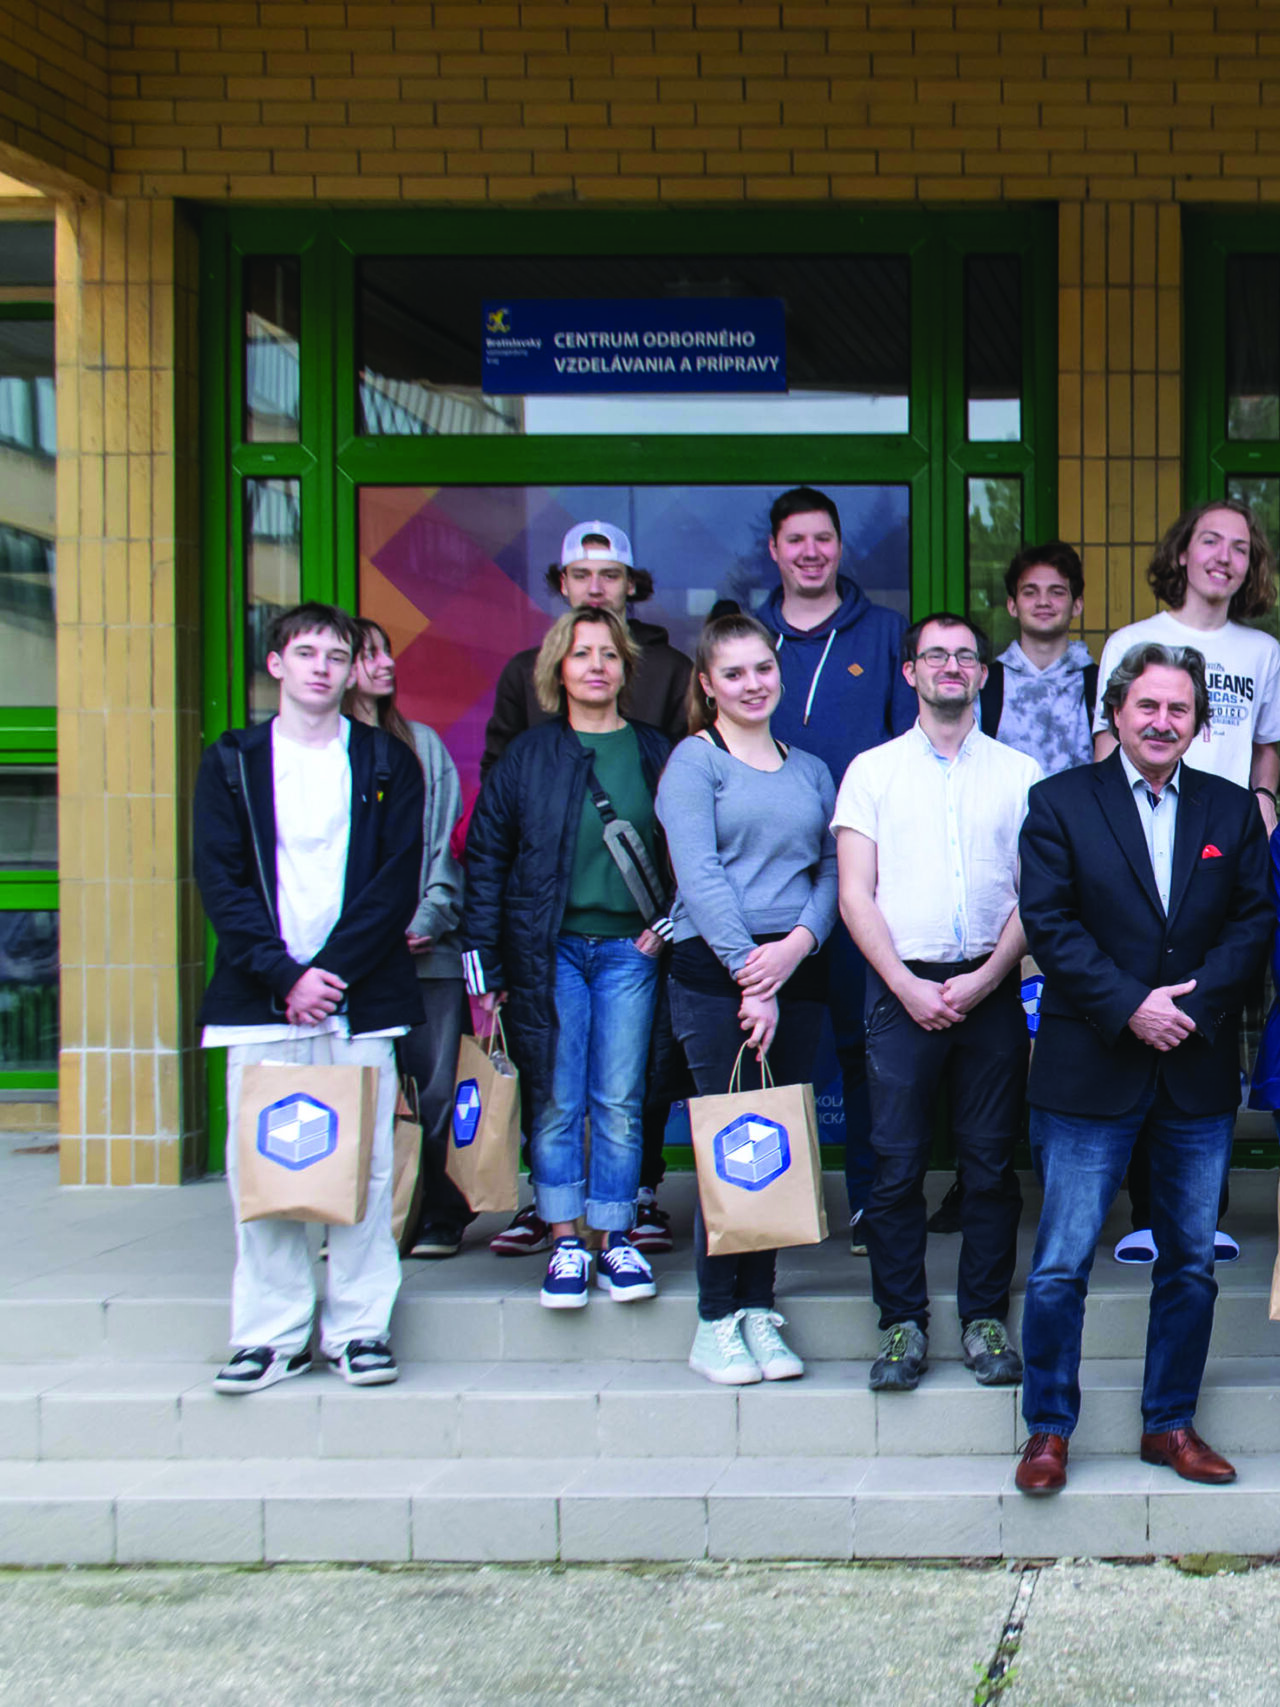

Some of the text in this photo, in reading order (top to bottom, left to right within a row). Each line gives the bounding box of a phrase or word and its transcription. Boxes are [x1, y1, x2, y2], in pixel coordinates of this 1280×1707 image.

[554, 328, 756, 348] CENTRUM ODBORNÉHO
[554, 352, 780, 373] VZDELÁVANIA A PRÍPRAVY
[1207, 673, 1254, 702] JEANS
